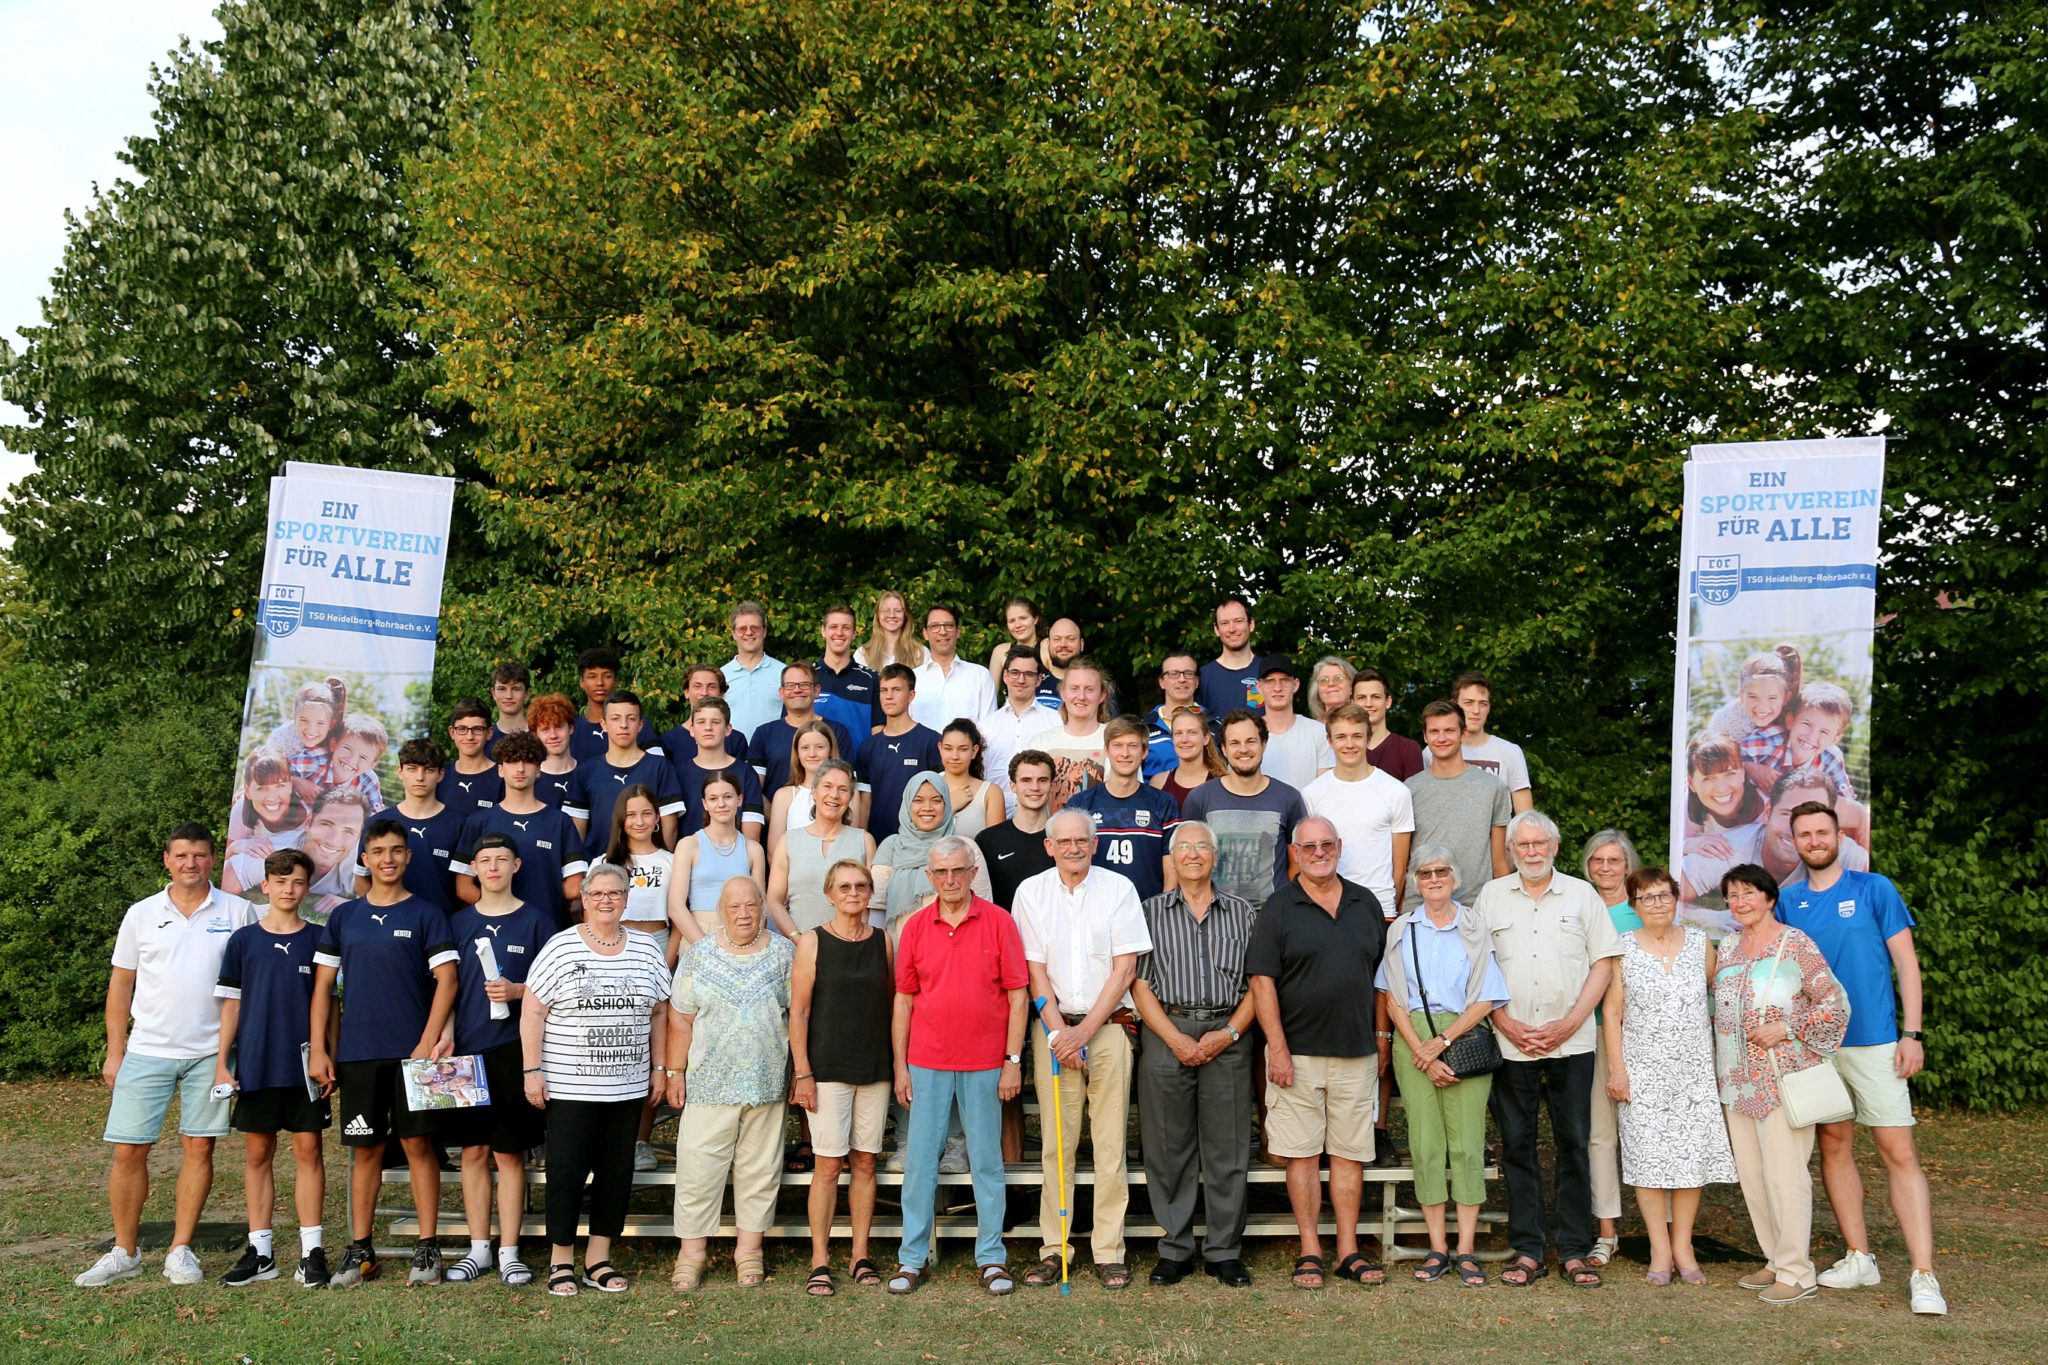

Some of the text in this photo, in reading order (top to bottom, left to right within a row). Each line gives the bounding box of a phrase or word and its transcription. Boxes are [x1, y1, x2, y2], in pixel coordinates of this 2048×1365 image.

[1748, 471, 1787, 488] EIN
[320, 500, 359, 520] EIN
[1699, 488, 1877, 514] SPORTVEREIN
[1717, 515, 1851, 542] FÜR ALLE
[274, 520, 442, 556] SPORTVEREIN
[284, 544, 413, 587] FÜR ALLE
[1746, 572, 1873, 584] TSG Heidelberg-Rohrbach e.V.
[1706, 589, 1729, 600] TSG
[270, 619, 290, 633] TSG
[308, 611, 432, 633] TSG Heidelberg-Rohrbach e.V.
[1105, 839, 1134, 865] 49
[652, 866, 662, 875] IS
[577, 997, 635, 1011] FASHION
[586, 1021, 633, 1047] exotic
[575, 1063, 628, 1076] SUMMER
[344, 1127, 374, 1136] adidas
